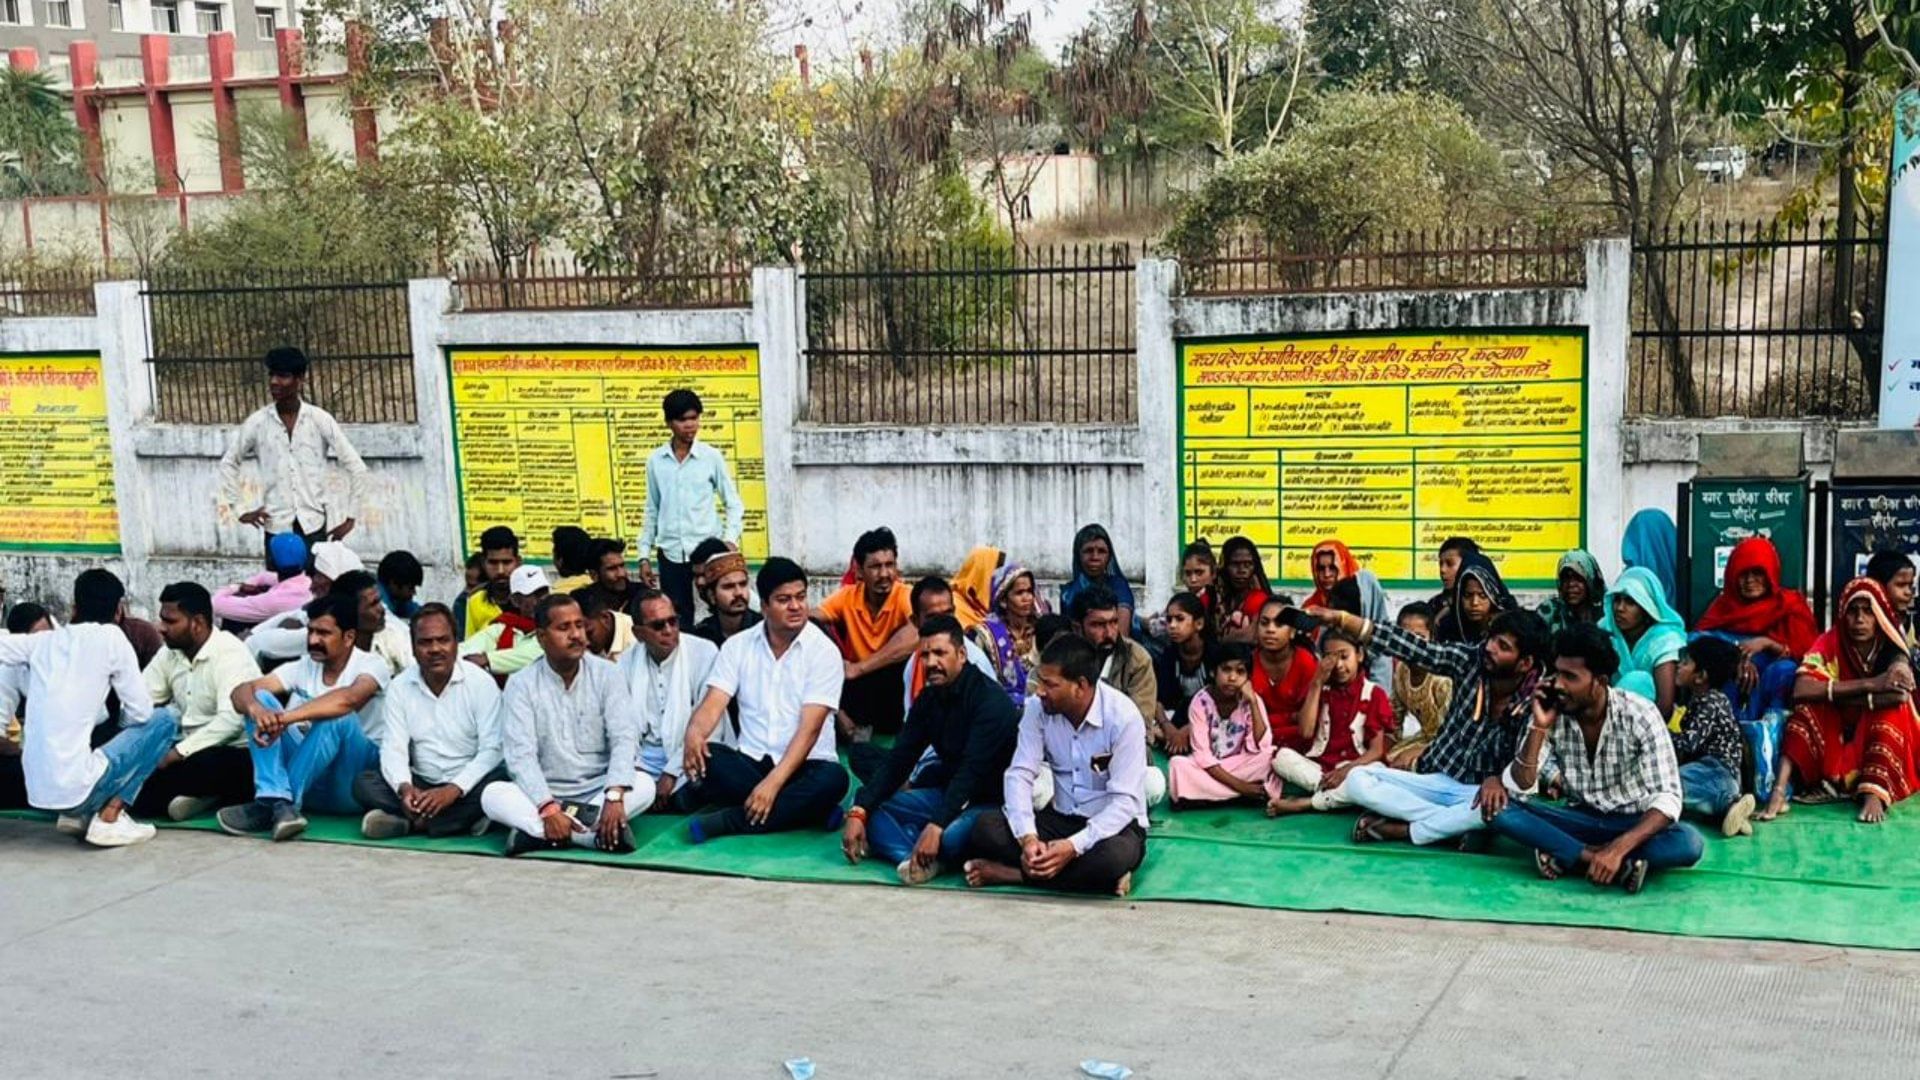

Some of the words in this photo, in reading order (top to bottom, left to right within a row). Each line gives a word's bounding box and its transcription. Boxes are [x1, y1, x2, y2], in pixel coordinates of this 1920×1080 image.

[1406, 340, 1469, 363] कर्मकार
[1470, 345, 1530, 362] कल्याण
[1411, 362, 1479, 381] संचालित
[1701, 491, 1723, 505] नगर
[1726, 487, 1760, 505] पालिका
[1765, 486, 1793, 505] परिषद
[1840, 497, 1865, 511] नगर
[1867, 494, 1901, 511] पालिका
[1870, 510, 1898, 531] सीहोर
